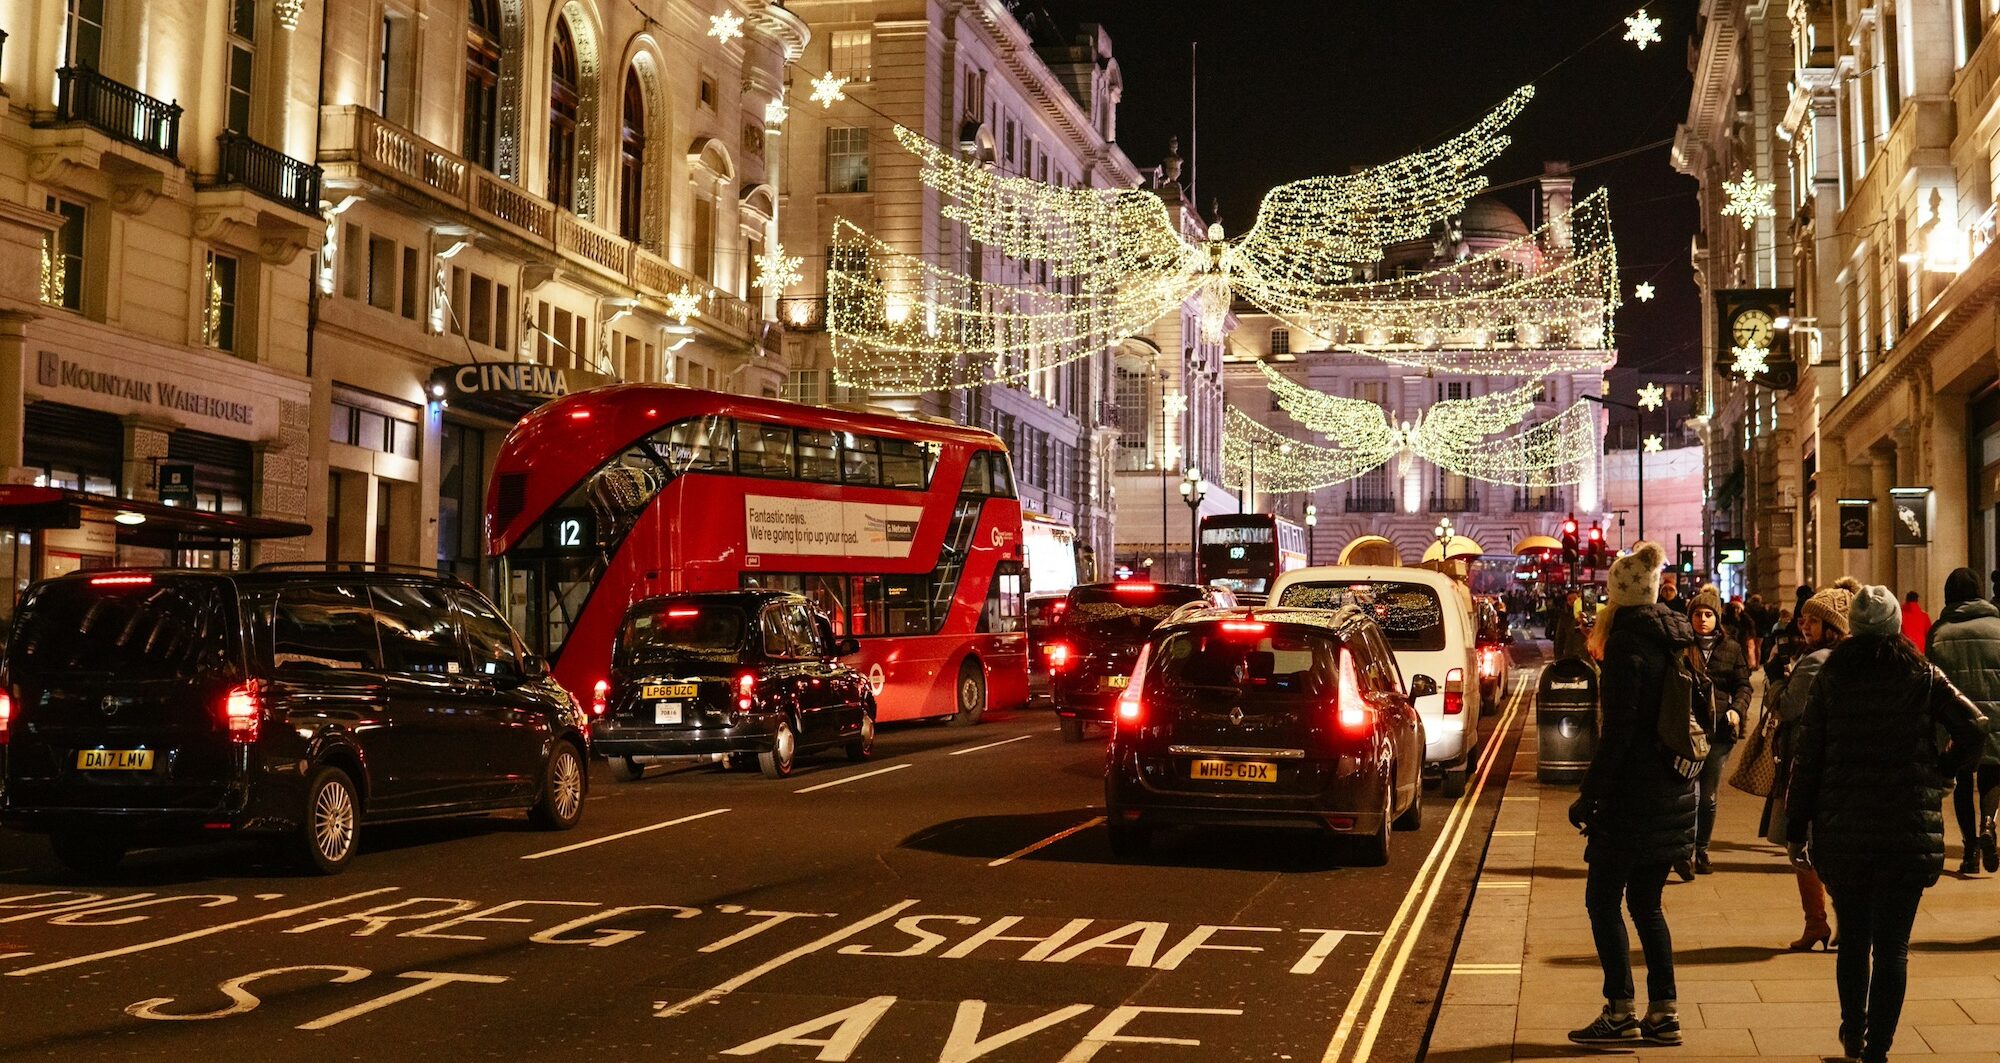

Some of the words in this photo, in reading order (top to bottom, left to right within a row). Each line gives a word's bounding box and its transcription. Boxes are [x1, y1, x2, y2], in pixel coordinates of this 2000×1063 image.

[61, 360, 152, 402] MOUNTAIN
[157, 381, 254, 425] WAREHOUSE
[455, 364, 569, 396] CINEMA
[749, 508, 785, 524] Fantastic
[785, 513, 807, 525] news.
[560, 519, 581, 546] 12
[750, 525, 772, 541] We're
[773, 526, 794, 544] going
[795, 528, 803, 542] to
[803, 527, 814, 545] rip
[814, 530, 823, 544] up
[825, 531, 841, 545] your
[841, 529, 859, 544] road.
[646, 686, 672, 697] LP66
[674, 685, 693, 696] UZC
[85, 752, 116, 768] DA17
[118, 752, 146, 768] LMV
[1200, 762, 1233, 777] WH15
[1237, 763, 1268, 779] GDX
[836, 914, 1384, 975] SHAFT
[125, 963, 510, 1030] ST
[719, 994, 1244, 1063] AVE
